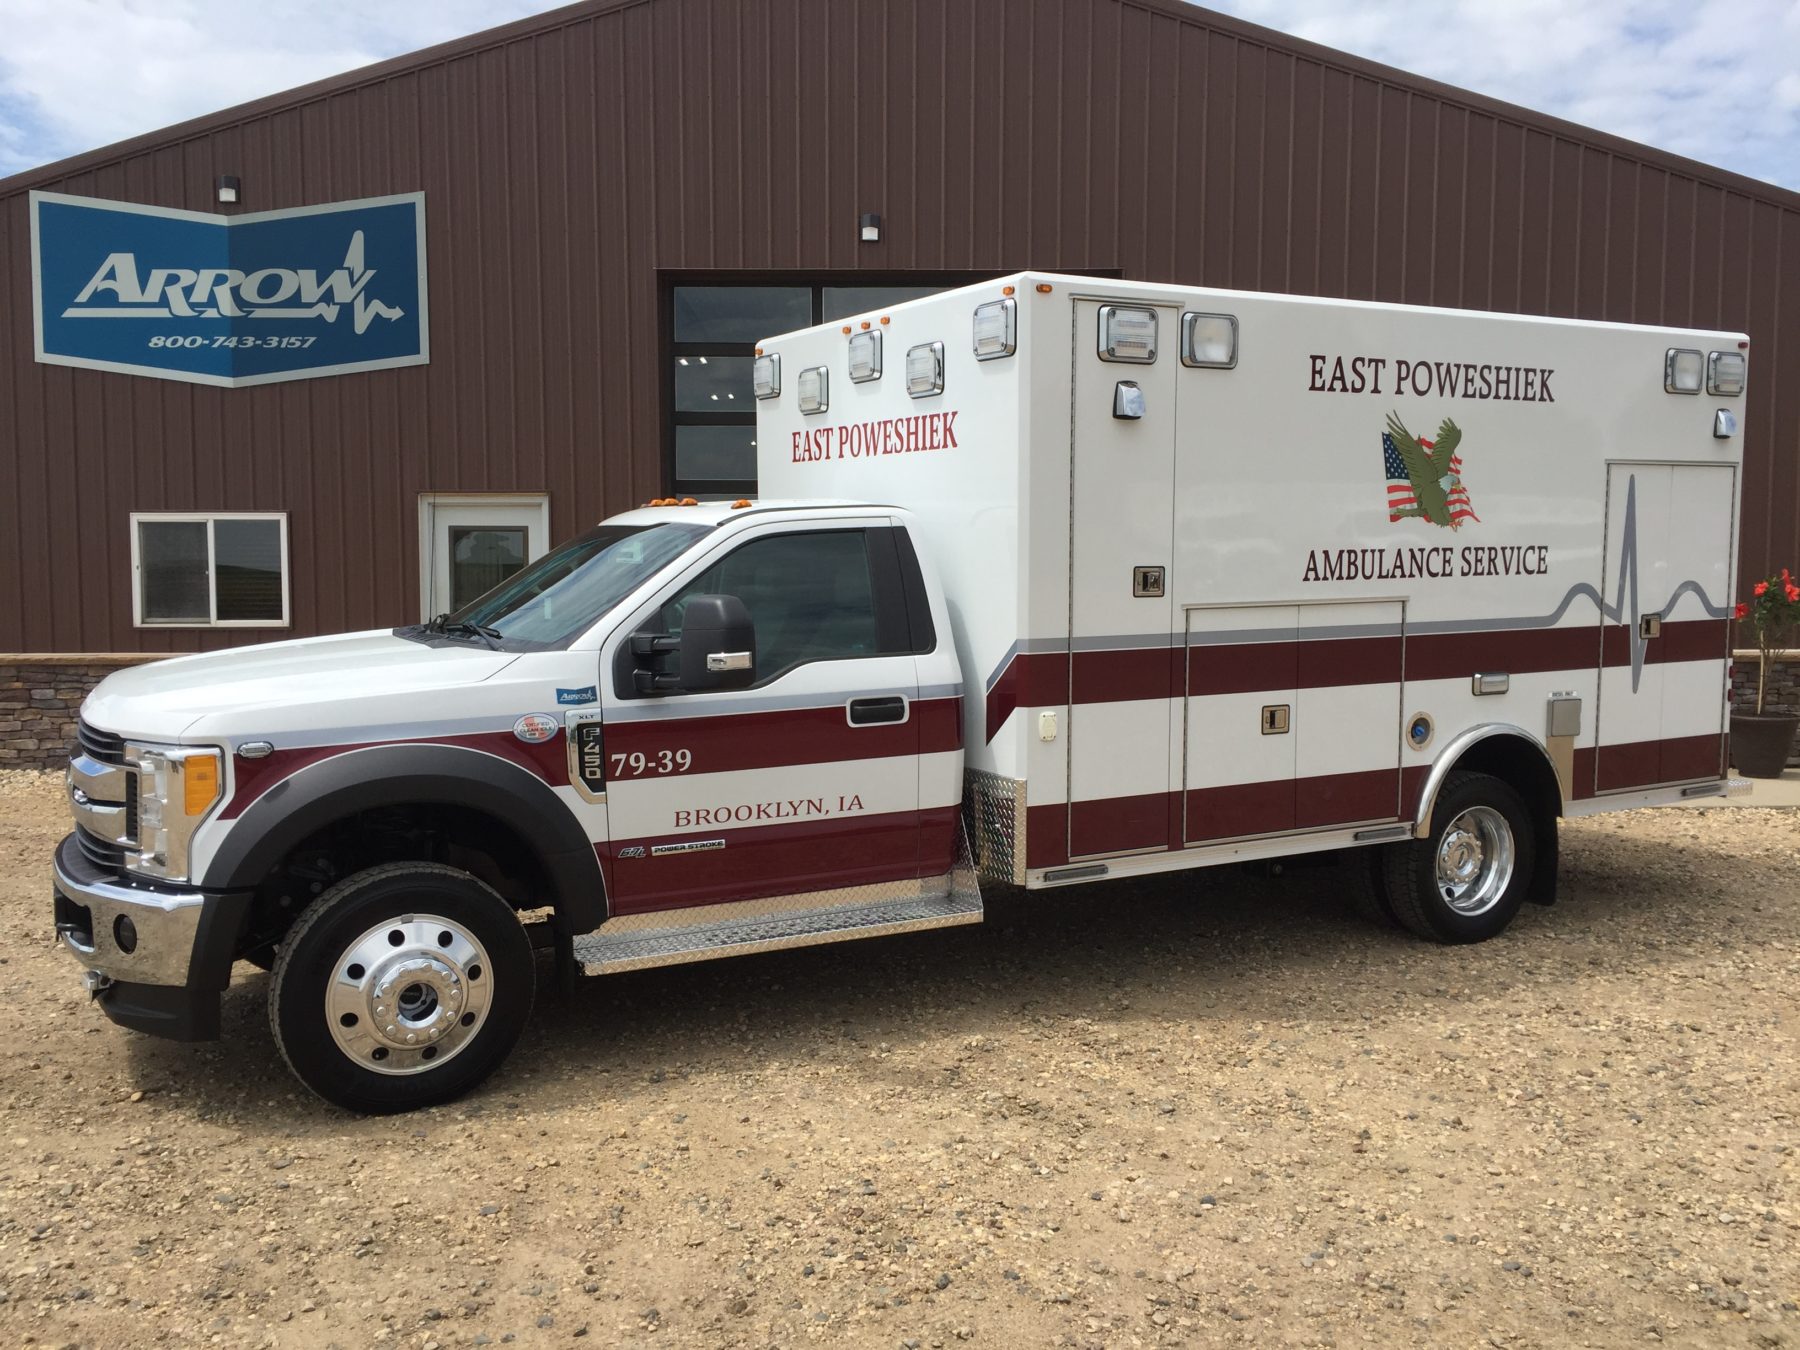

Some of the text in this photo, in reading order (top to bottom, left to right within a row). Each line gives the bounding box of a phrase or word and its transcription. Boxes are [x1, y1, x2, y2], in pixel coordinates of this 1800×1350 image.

[73, 252, 377, 318] ARROW
[148, 335, 317, 349] 800-743-3157
[1308, 354, 1555, 403] EAST POWESHIEK
[791, 410, 958, 463] EAST POWESHIEK
[1302, 545, 1549, 582] AMBULANCE SERVICE
[611, 748, 692, 777] 79-39
[674, 794, 865, 828] BROOKLYN, IA
[687, 840, 724, 849] STROKE
